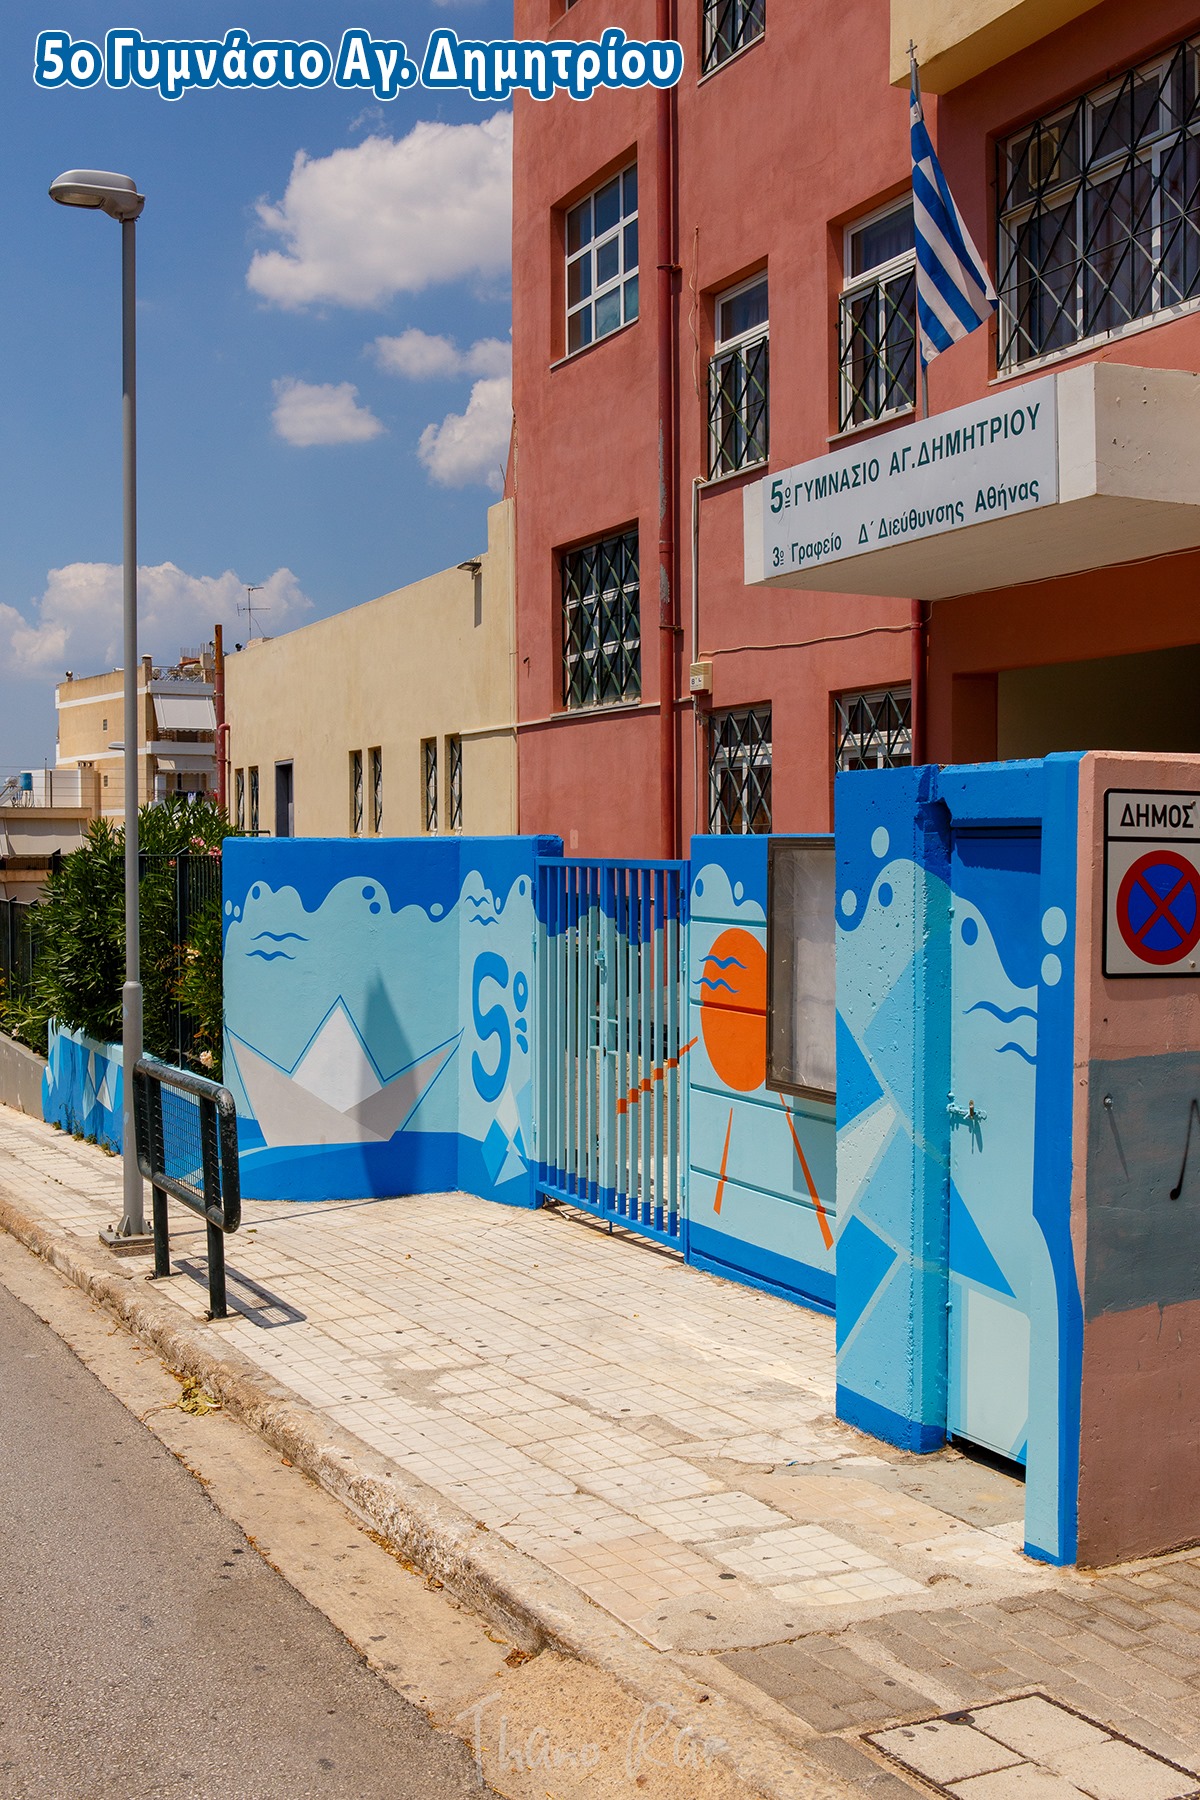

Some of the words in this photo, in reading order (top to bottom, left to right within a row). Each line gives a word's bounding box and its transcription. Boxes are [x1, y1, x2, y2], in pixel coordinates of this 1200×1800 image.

[794, 458, 880, 506] ΓΥΜΝΑΣΙΟ
[791, 532, 842, 564] Γραφείο
[878, 500, 964, 540] Διεύθυνσης
[975, 479, 1039, 512] Αθήνας
[1120, 803, 1194, 828] ΔΗΜΟΣ
